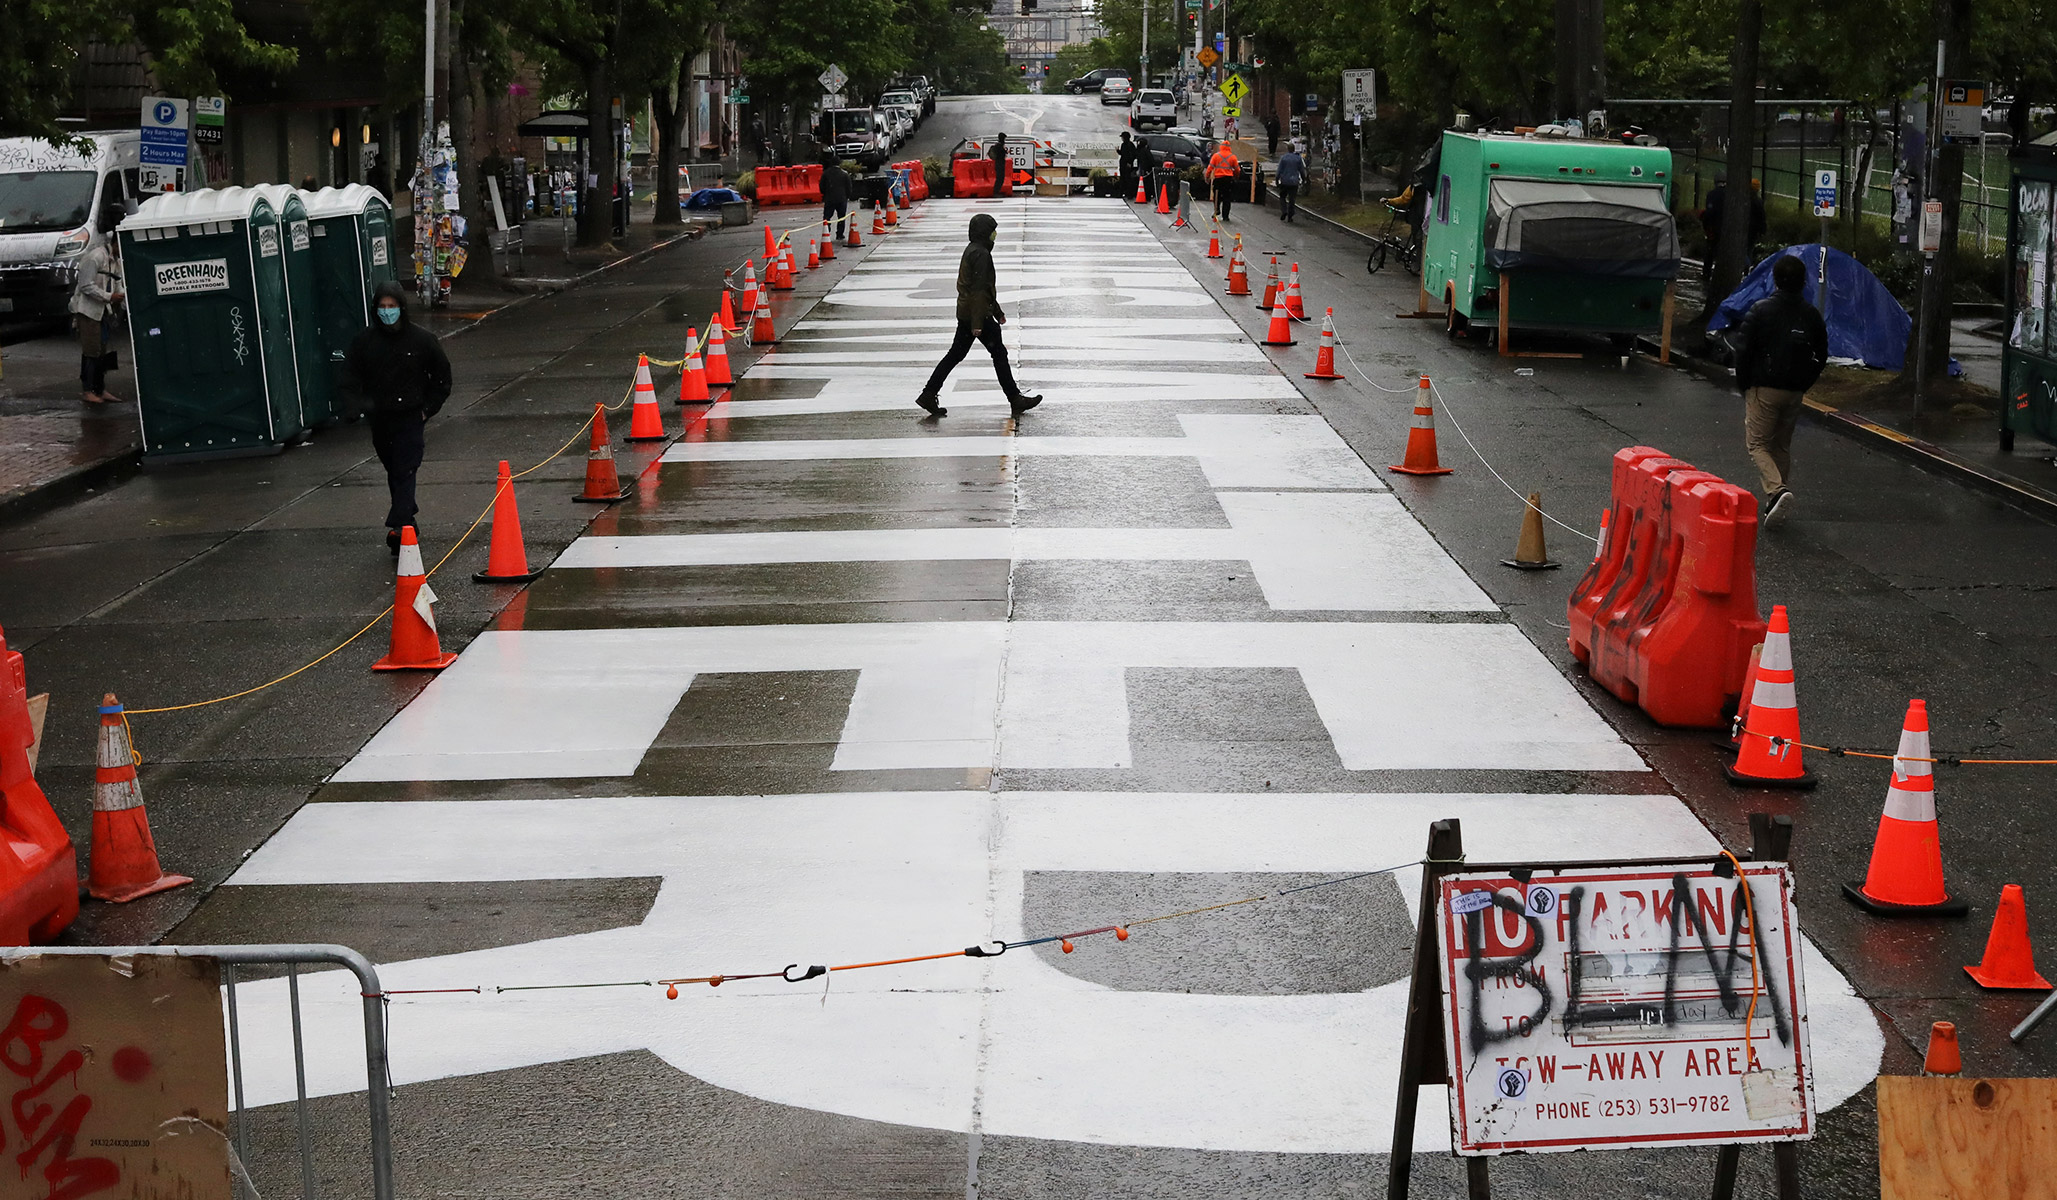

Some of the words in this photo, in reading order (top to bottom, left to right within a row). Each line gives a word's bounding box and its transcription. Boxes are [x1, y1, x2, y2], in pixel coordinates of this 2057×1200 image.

[197, 129, 221, 139] 87431
[142, 146, 149, 155] 2
[149, 149, 170, 157] Hours
[171, 150, 185, 158] Max
[158, 264, 225, 285] GREENHAUS
[1451, 887, 1527, 950] NO
[1465, 873, 1788, 1056] BLM
[1502, 1015, 1532, 1037] TO
[1685, 1046, 1762, 1078] AREA
[1536, 1101, 1591, 1120] PHONE
[1598, 1099, 1642, 1118] (253)
[1650, 1095, 1730, 1115] 531-9782
